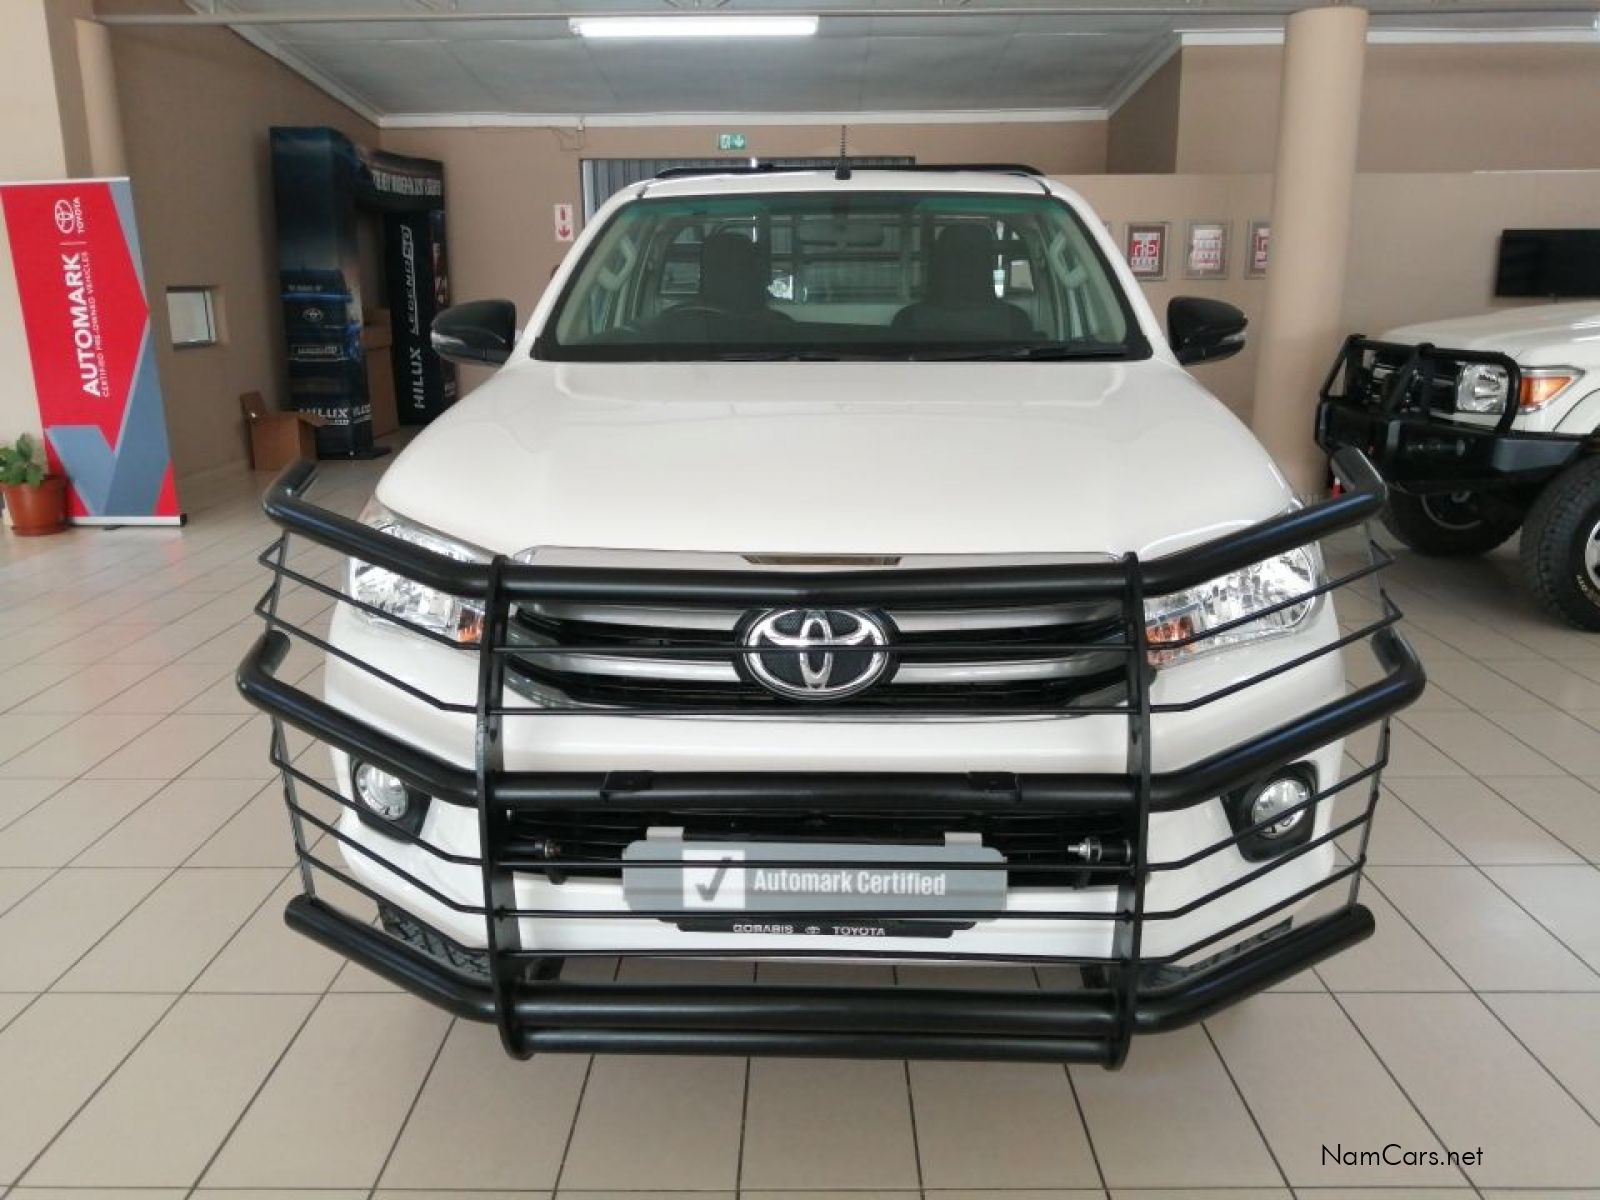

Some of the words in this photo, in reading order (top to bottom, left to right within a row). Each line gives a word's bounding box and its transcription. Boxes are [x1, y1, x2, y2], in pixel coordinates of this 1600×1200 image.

[73, 196, 85, 234] TOYOTA
[81, 251, 94, 294] VEHICLES
[61, 253, 101, 397] AUTOMARK
[96, 353, 109, 397] CERTIFIED
[409, 346, 425, 409] HILUX
[754, 870, 853, 893] Automark
[857, 871, 946, 896] Certified
[832, 926, 886, 936] TOYOTA
